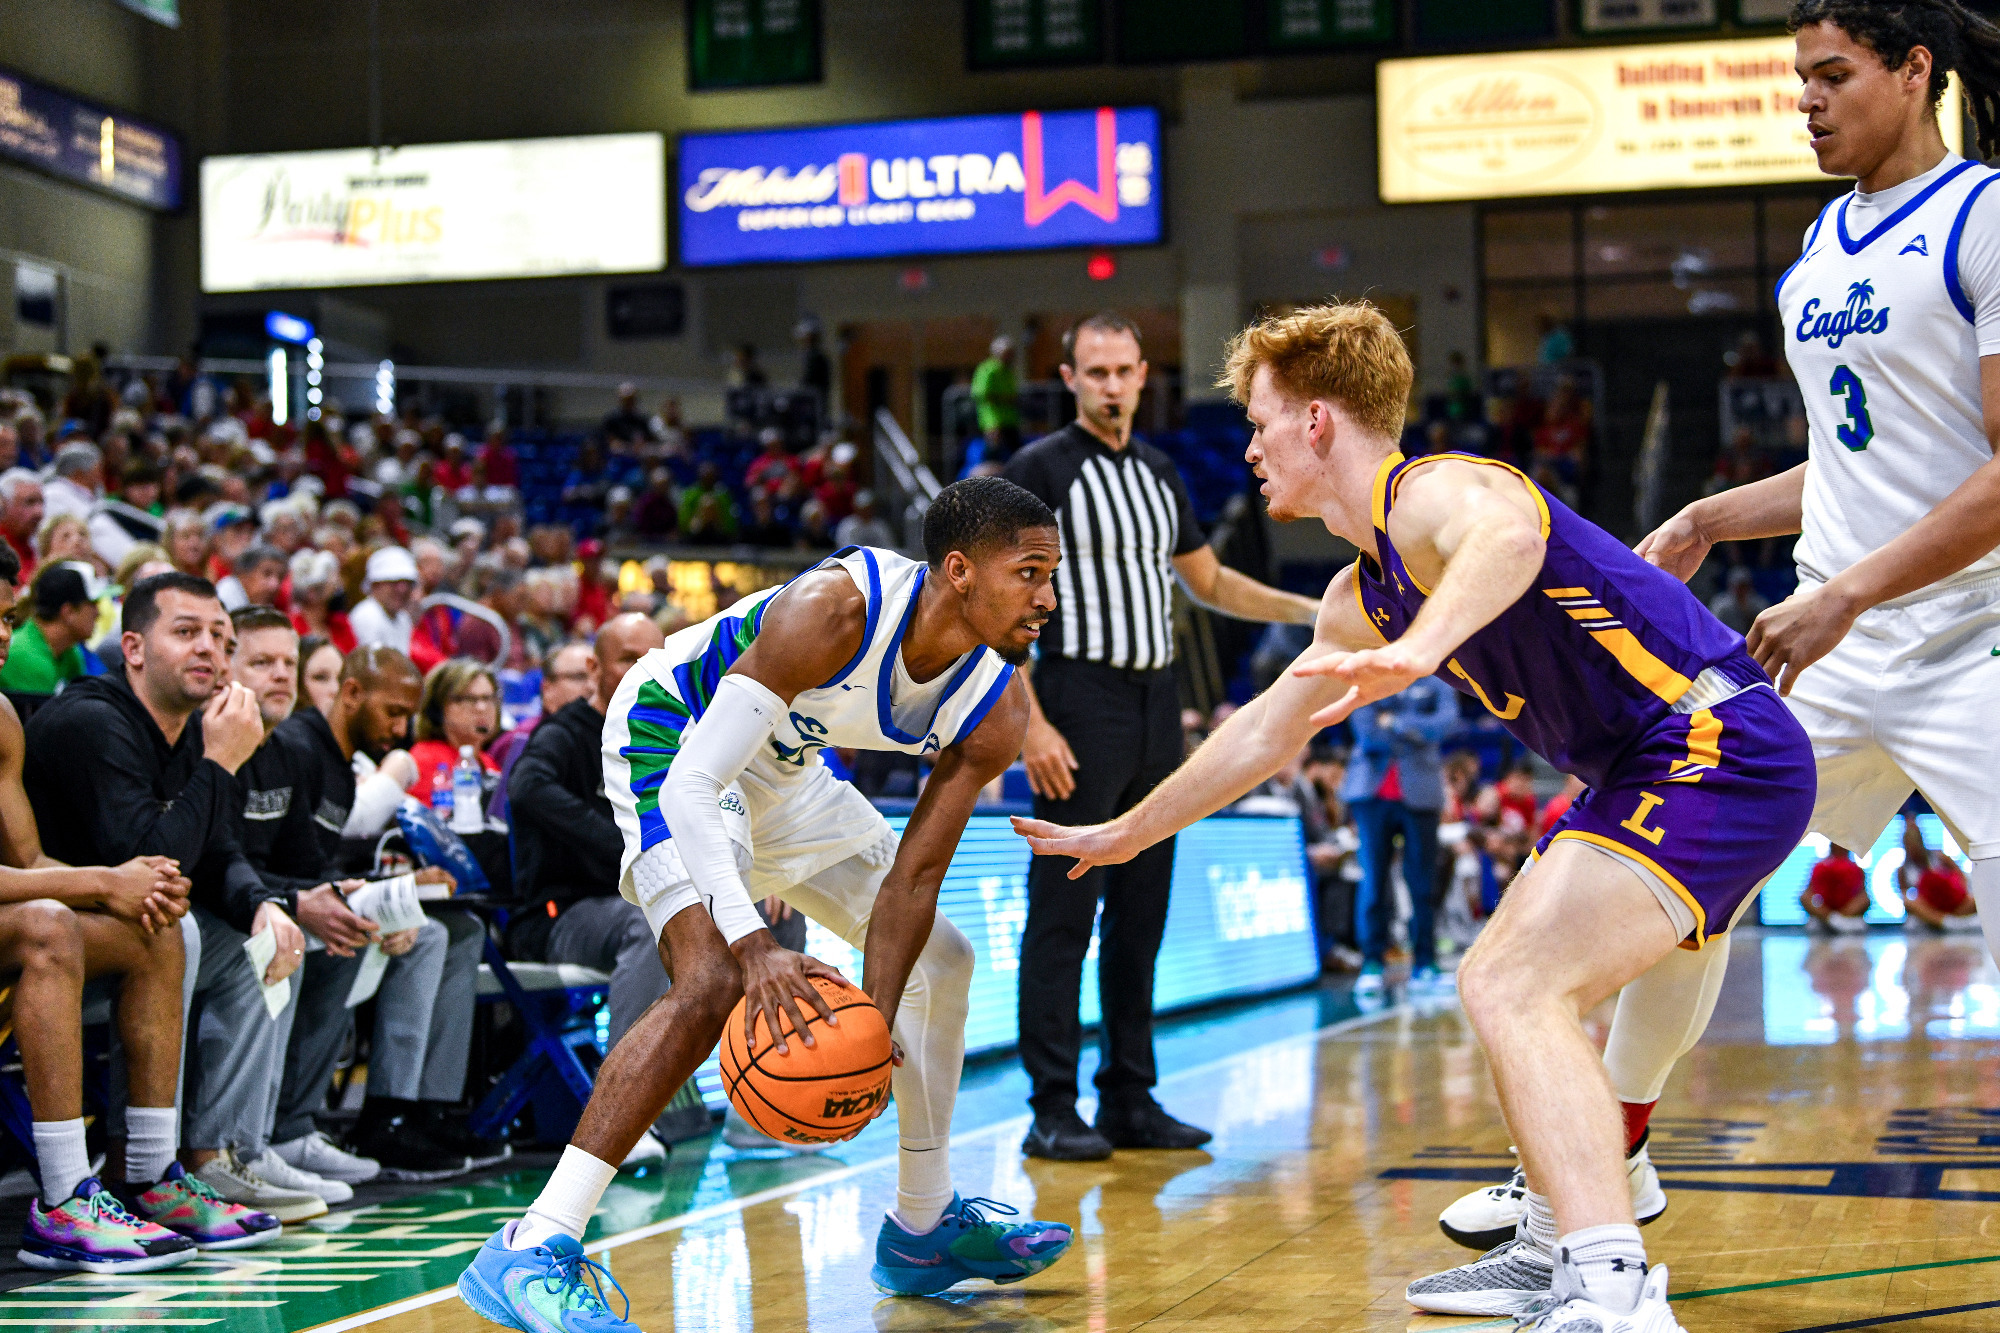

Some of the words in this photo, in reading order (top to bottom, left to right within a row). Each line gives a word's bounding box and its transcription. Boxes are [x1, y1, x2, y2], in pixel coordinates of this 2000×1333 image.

[870, 151, 1026, 200] ULTRA
[349, 197, 443, 246] Plus
[1796, 279, 1891, 349] Eagles
[1829, 364, 1875, 452] 3
[1619, 790, 1666, 846] L
[822, 1082, 887, 1118] NCAA
